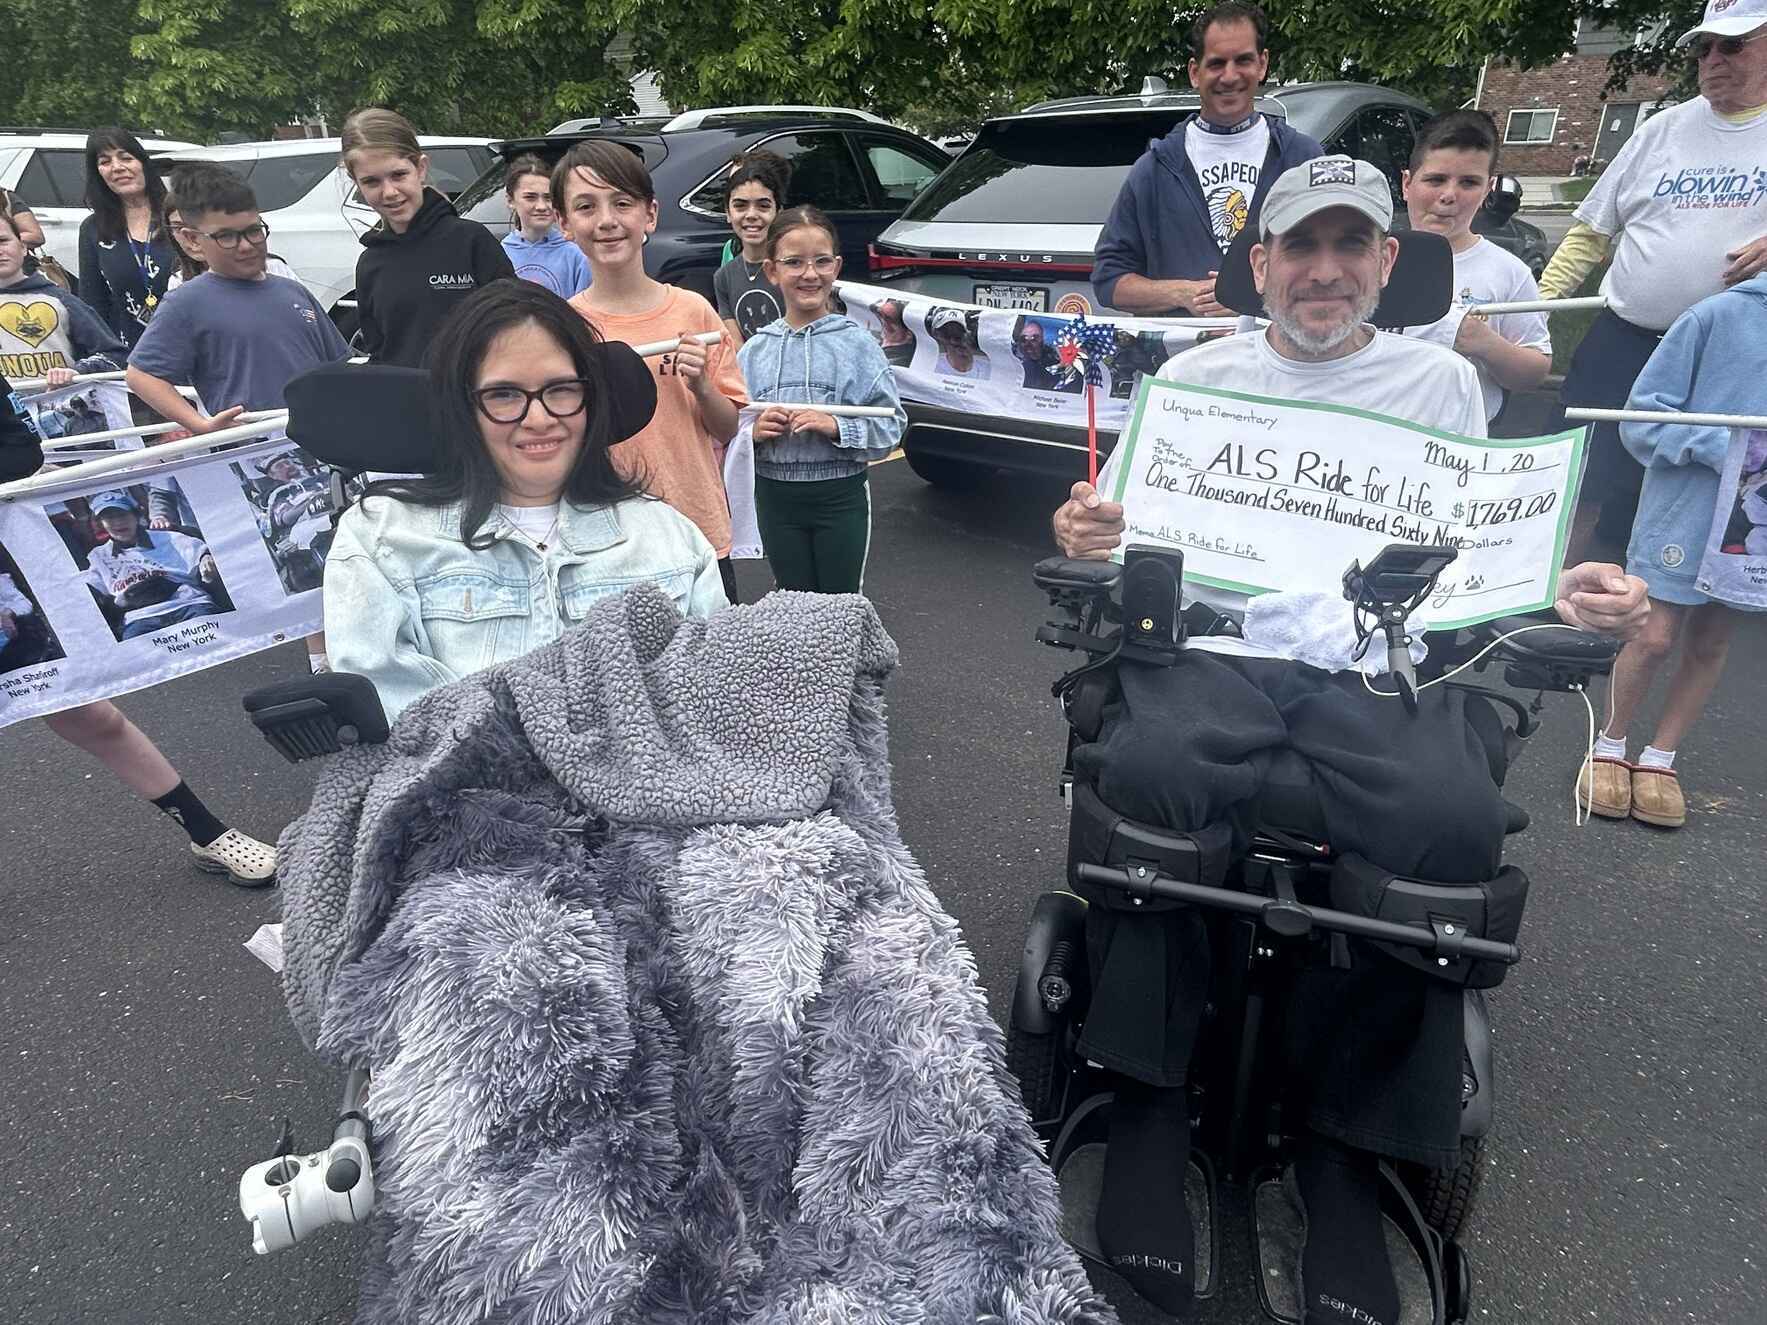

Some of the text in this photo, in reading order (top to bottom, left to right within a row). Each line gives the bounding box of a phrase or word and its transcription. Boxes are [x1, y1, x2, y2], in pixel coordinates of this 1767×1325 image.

[1684, 165, 1728, 176] cure is
[1671, 188, 1755, 204] in the wind
[958, 252, 1053, 263] LEXUS
[429, 272, 474, 285] CARA MIA
[1162, 399, 1278, 430] Unqua Elementary
[1152, 455, 1193, 469] Order of
[1424, 441, 1476, 488] May
[1206, 442, 1433, 517] ALS Ride for Life
[1145, 461, 1513, 550] One Thousand Seven Hundred Sixty Nine Dollars
[1157, 525, 1183, 542] ALS
[1188, 532, 1213, 549] Ride
[1234, 544, 1258, 559] Life
[152, 620, 220, 647] Mary Murphy
[167, 632, 217, 653] New York
[8, 687, 31, 698] New
